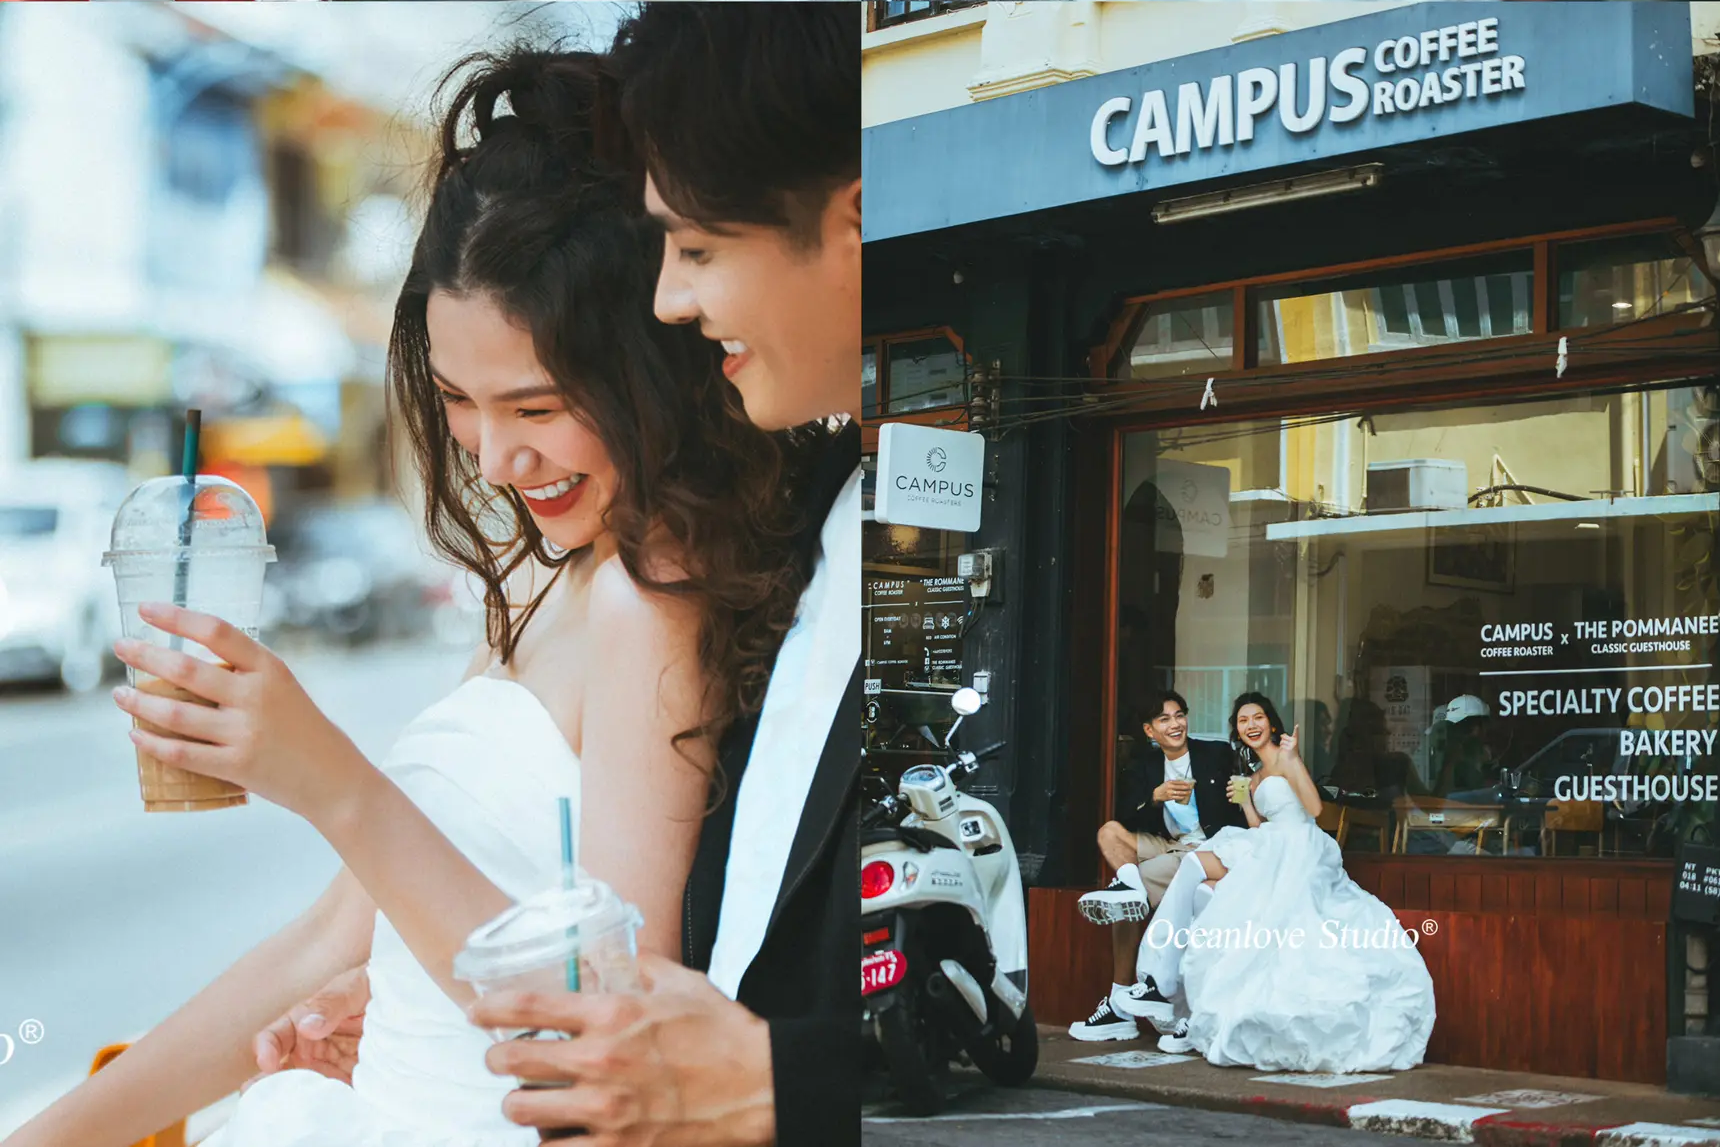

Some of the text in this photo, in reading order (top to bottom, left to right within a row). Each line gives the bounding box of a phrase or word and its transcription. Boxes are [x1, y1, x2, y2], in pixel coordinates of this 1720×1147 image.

[1373, 16, 1499, 74] COFFEE
[1373, 54, 1526, 116] ROASTER
[1090, 46, 1371, 167] CAMPUS
[896, 475, 974, 498] CAMPUS
[907, 495, 929, 503] COFFEE
[873, 581, 904, 589] CAMPUS
[923, 578, 933, 586] THE
[1480, 622, 1553, 642] CAMPUS
[1573, 620, 1608, 639] THE
[1480, 646, 1553, 657] COFFEE ROASTER
[1591, 640, 1691, 654] CLASSIC GUESTHOUSE
[865, 682, 880, 691] PUSH
[1499, 684, 1720, 717] SPECIALTY COFFEE
[1620, 729, 1718, 756] BAKERY
[1554, 774, 1718, 802] GUESTHOUSE
